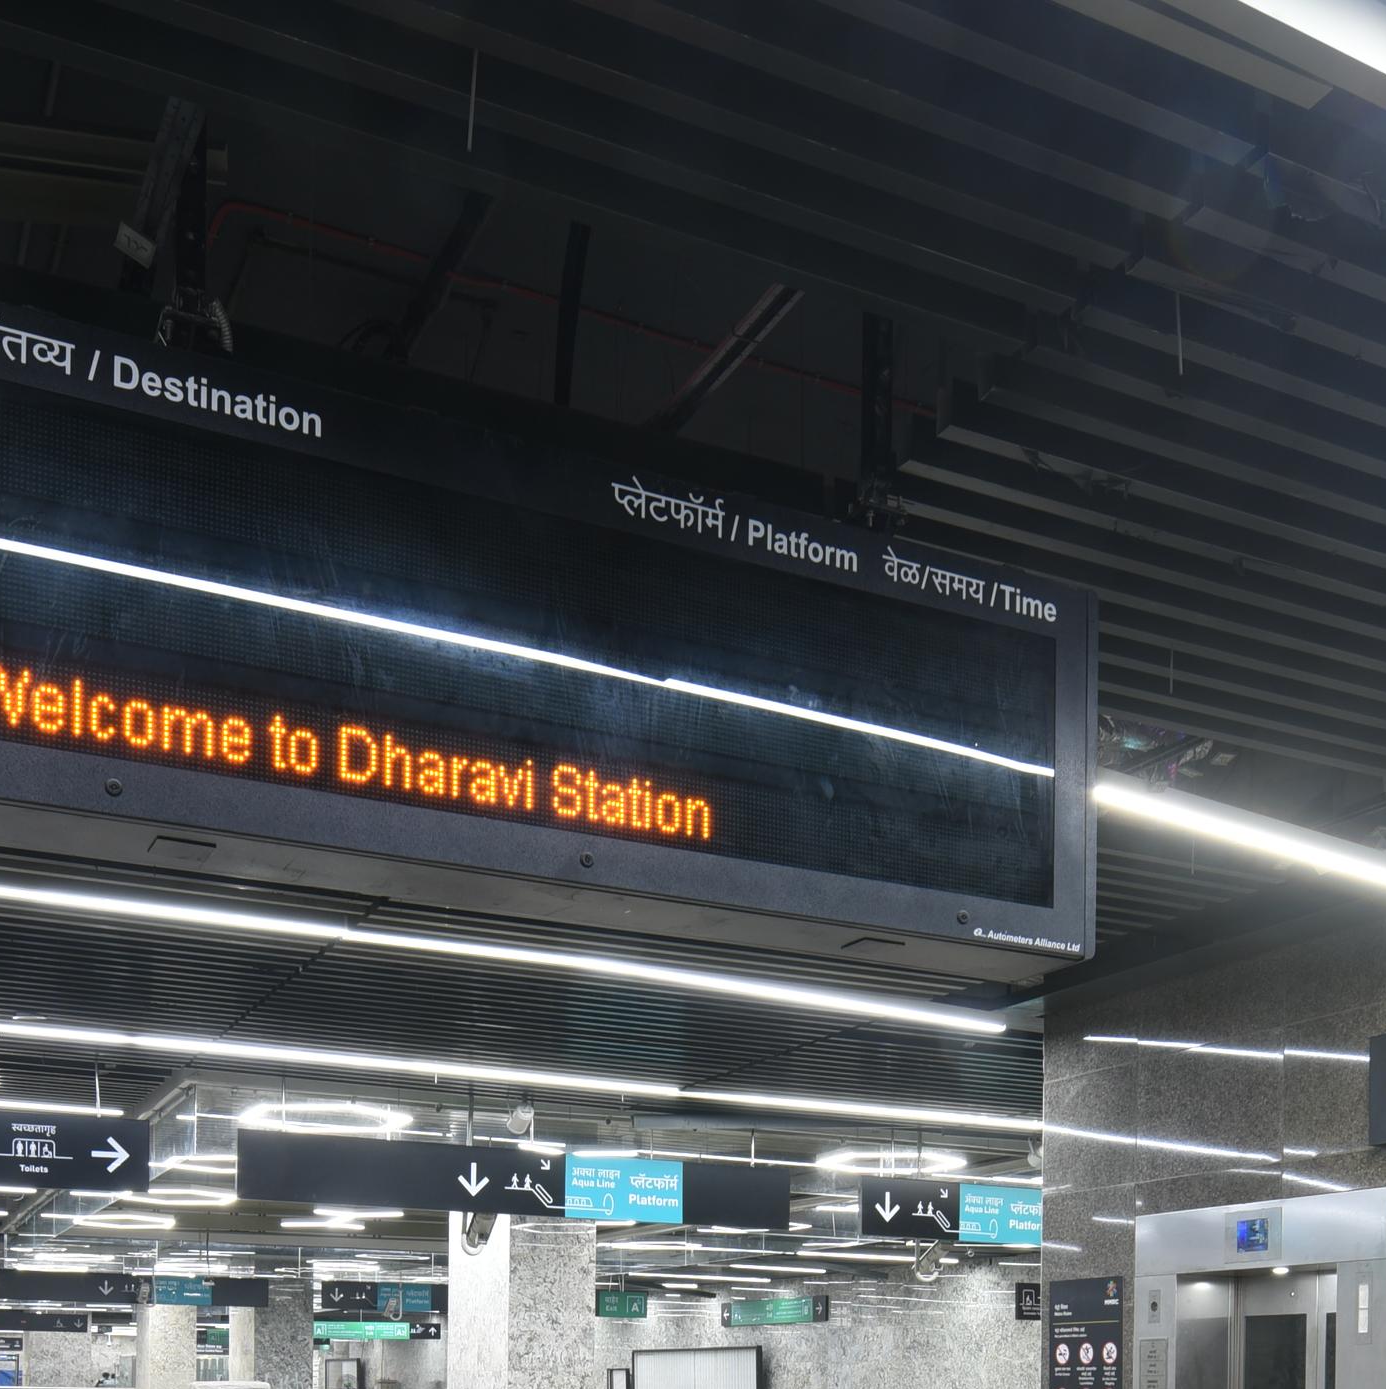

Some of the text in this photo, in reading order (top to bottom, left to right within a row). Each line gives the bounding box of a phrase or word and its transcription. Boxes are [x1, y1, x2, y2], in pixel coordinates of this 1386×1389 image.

[113, 354, 323, 438] Destination
[611, 475, 726, 539] प्लेटफॉर्म
[748, 518, 859, 573] Platform
[269, 714, 319, 774] to
[338, 724, 534, 812] Dharavi
[552, 764, 712, 840] Station
[987, 930, 1081, 952] Autometers Alliance Ltd
[19, 1164, 49, 1173] Toilets
[597, 1168, 621, 1180] लाइन
[571, 1178, 616, 1189] Aqua Line
[628, 1193, 679, 1207] Platform
[965, 1205, 999, 1215] Aqua Line
[1009, 1219, 1042, 1231] Platfor
